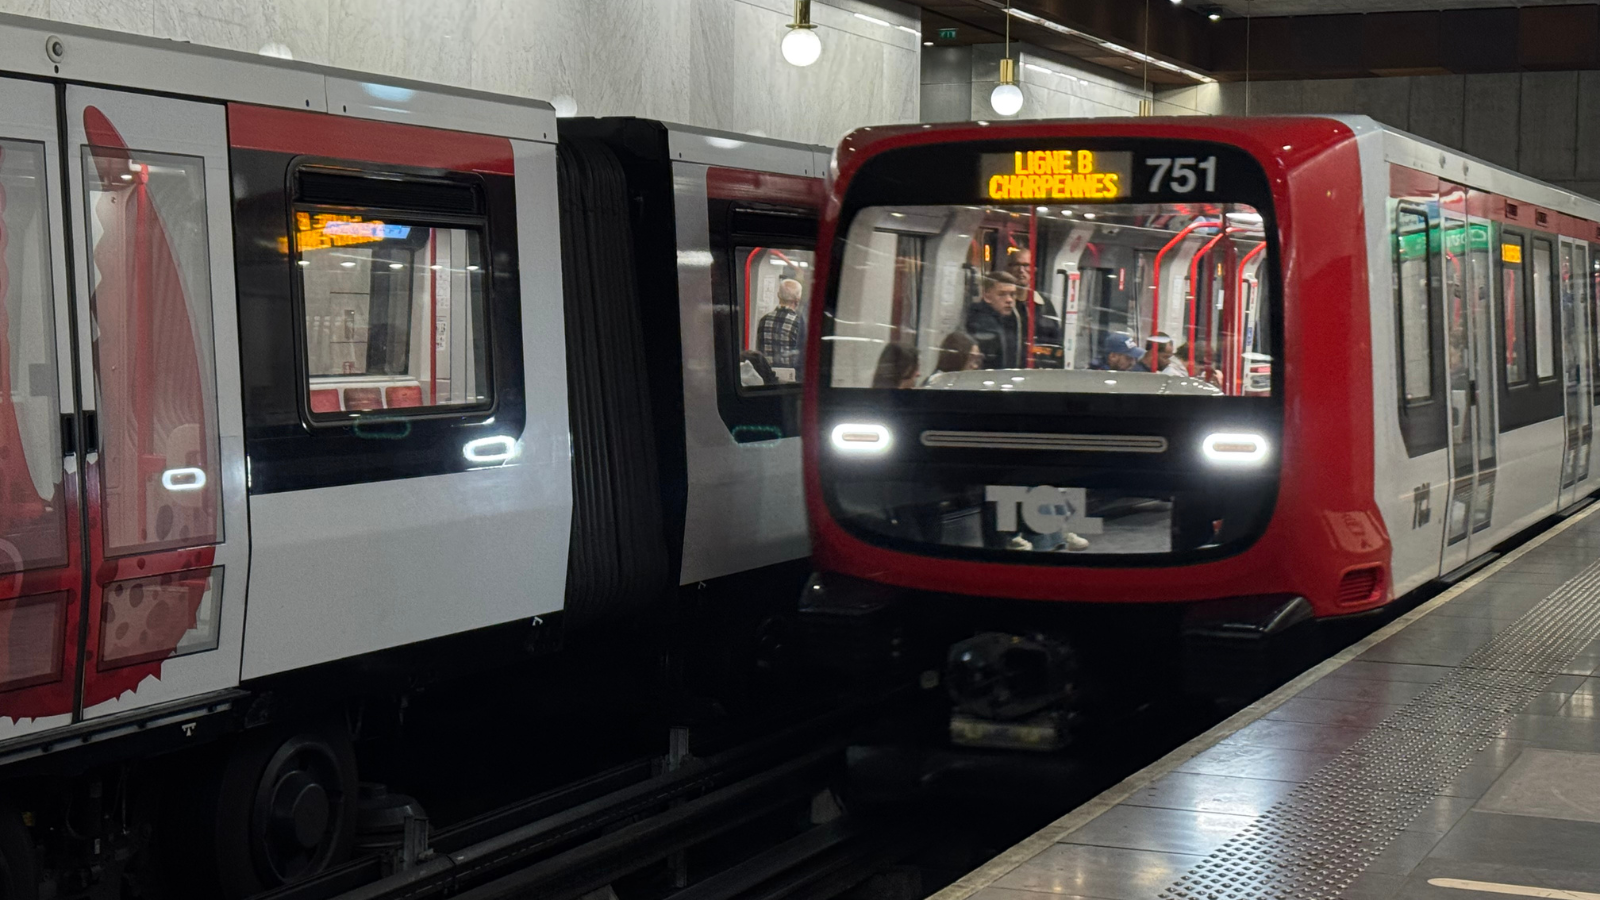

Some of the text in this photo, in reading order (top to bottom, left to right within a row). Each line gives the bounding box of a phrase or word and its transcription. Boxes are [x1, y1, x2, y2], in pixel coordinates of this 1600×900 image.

[1014, 149, 1094, 175] LIGNE B
[1145, 156, 1217, 193] 751
[988, 173, 1119, 200] CHARPENNES
[985, 485, 1103, 534] TCL
